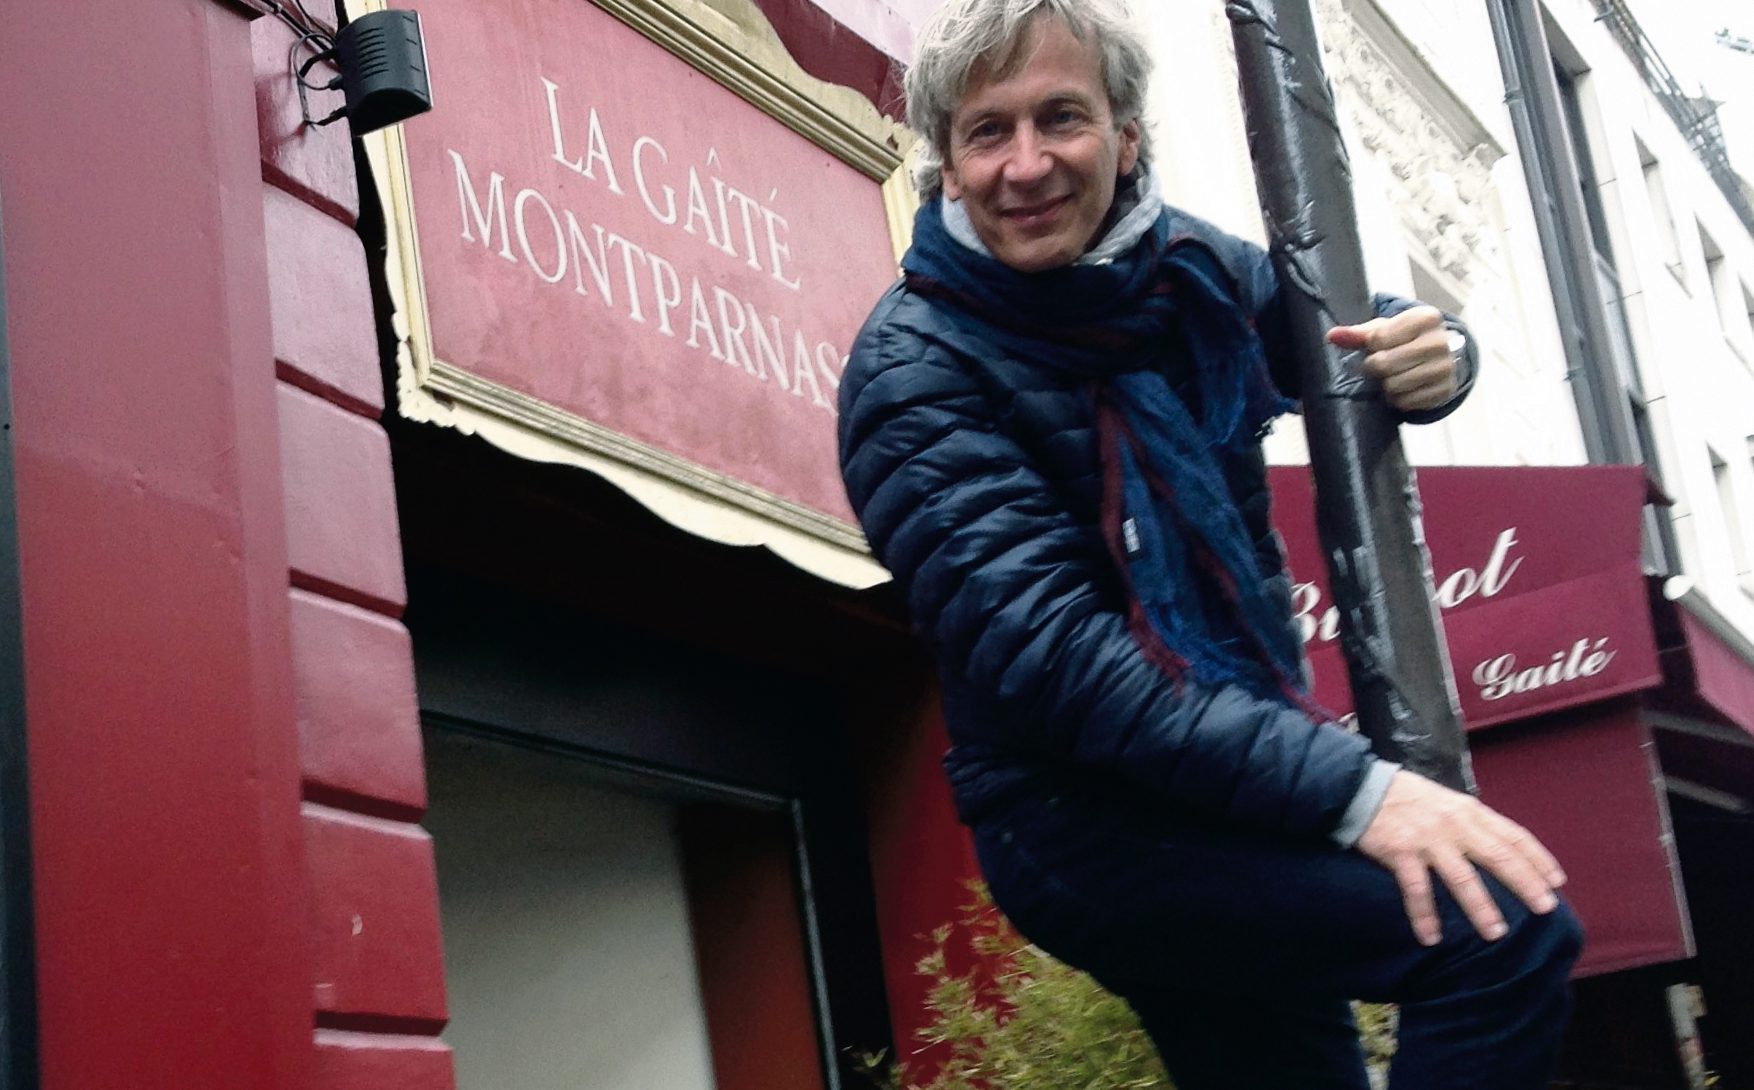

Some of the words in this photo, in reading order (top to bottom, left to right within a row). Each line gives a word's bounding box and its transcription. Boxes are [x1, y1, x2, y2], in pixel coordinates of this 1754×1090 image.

[447, 148, 850, 417] MONTPARNAS
[540, 76, 624, 196] LA
[632, 136, 801, 290] GAÎTÉ
[1290, 525, 1525, 643] Biot
